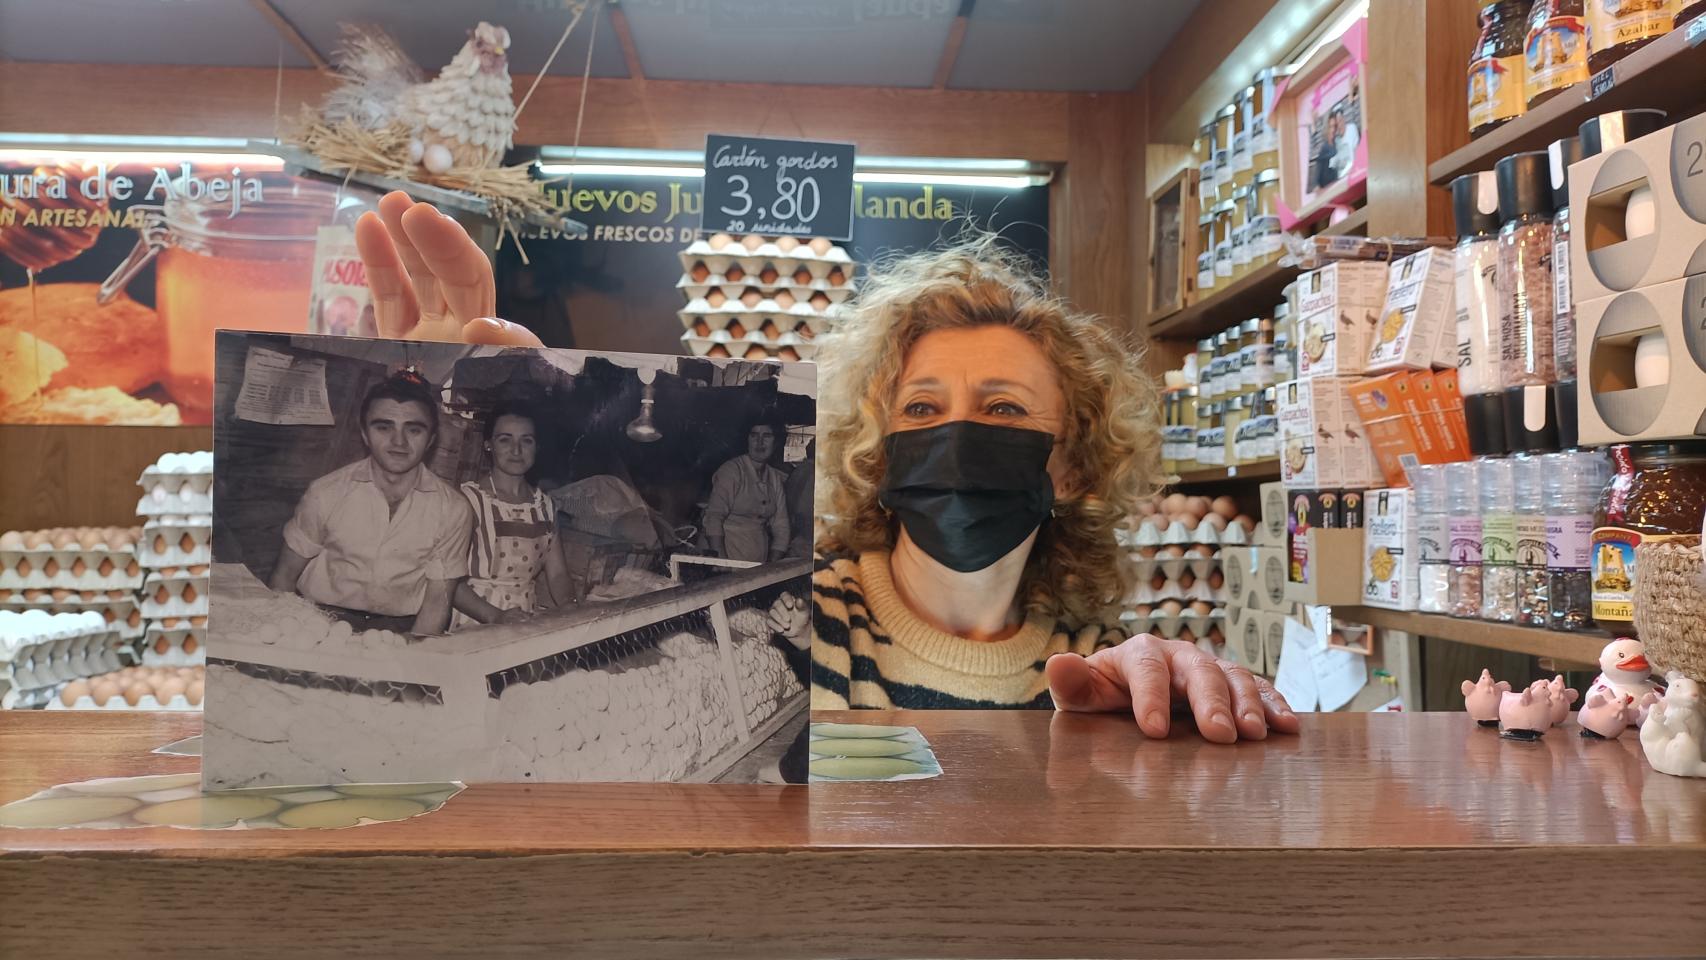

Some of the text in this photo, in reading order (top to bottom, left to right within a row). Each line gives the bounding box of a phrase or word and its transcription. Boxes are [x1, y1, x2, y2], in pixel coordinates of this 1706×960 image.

[712, 144, 838, 183] Cartón gordos
[80, 162, 134, 200] de
[144, 162, 264, 219] Abeja
[538, 183, 657, 213] uevos
[854, 184, 953, 219] landa
[721, 174, 821, 223] 3,80
[23, 207, 145, 228] ARTESANAL
[594, 225, 675, 243] FRESCOS
[727, 219, 745, 232] 20
[1458, 338, 1472, 368] SAL
[1501, 314, 1512, 361] SAL ROSA
